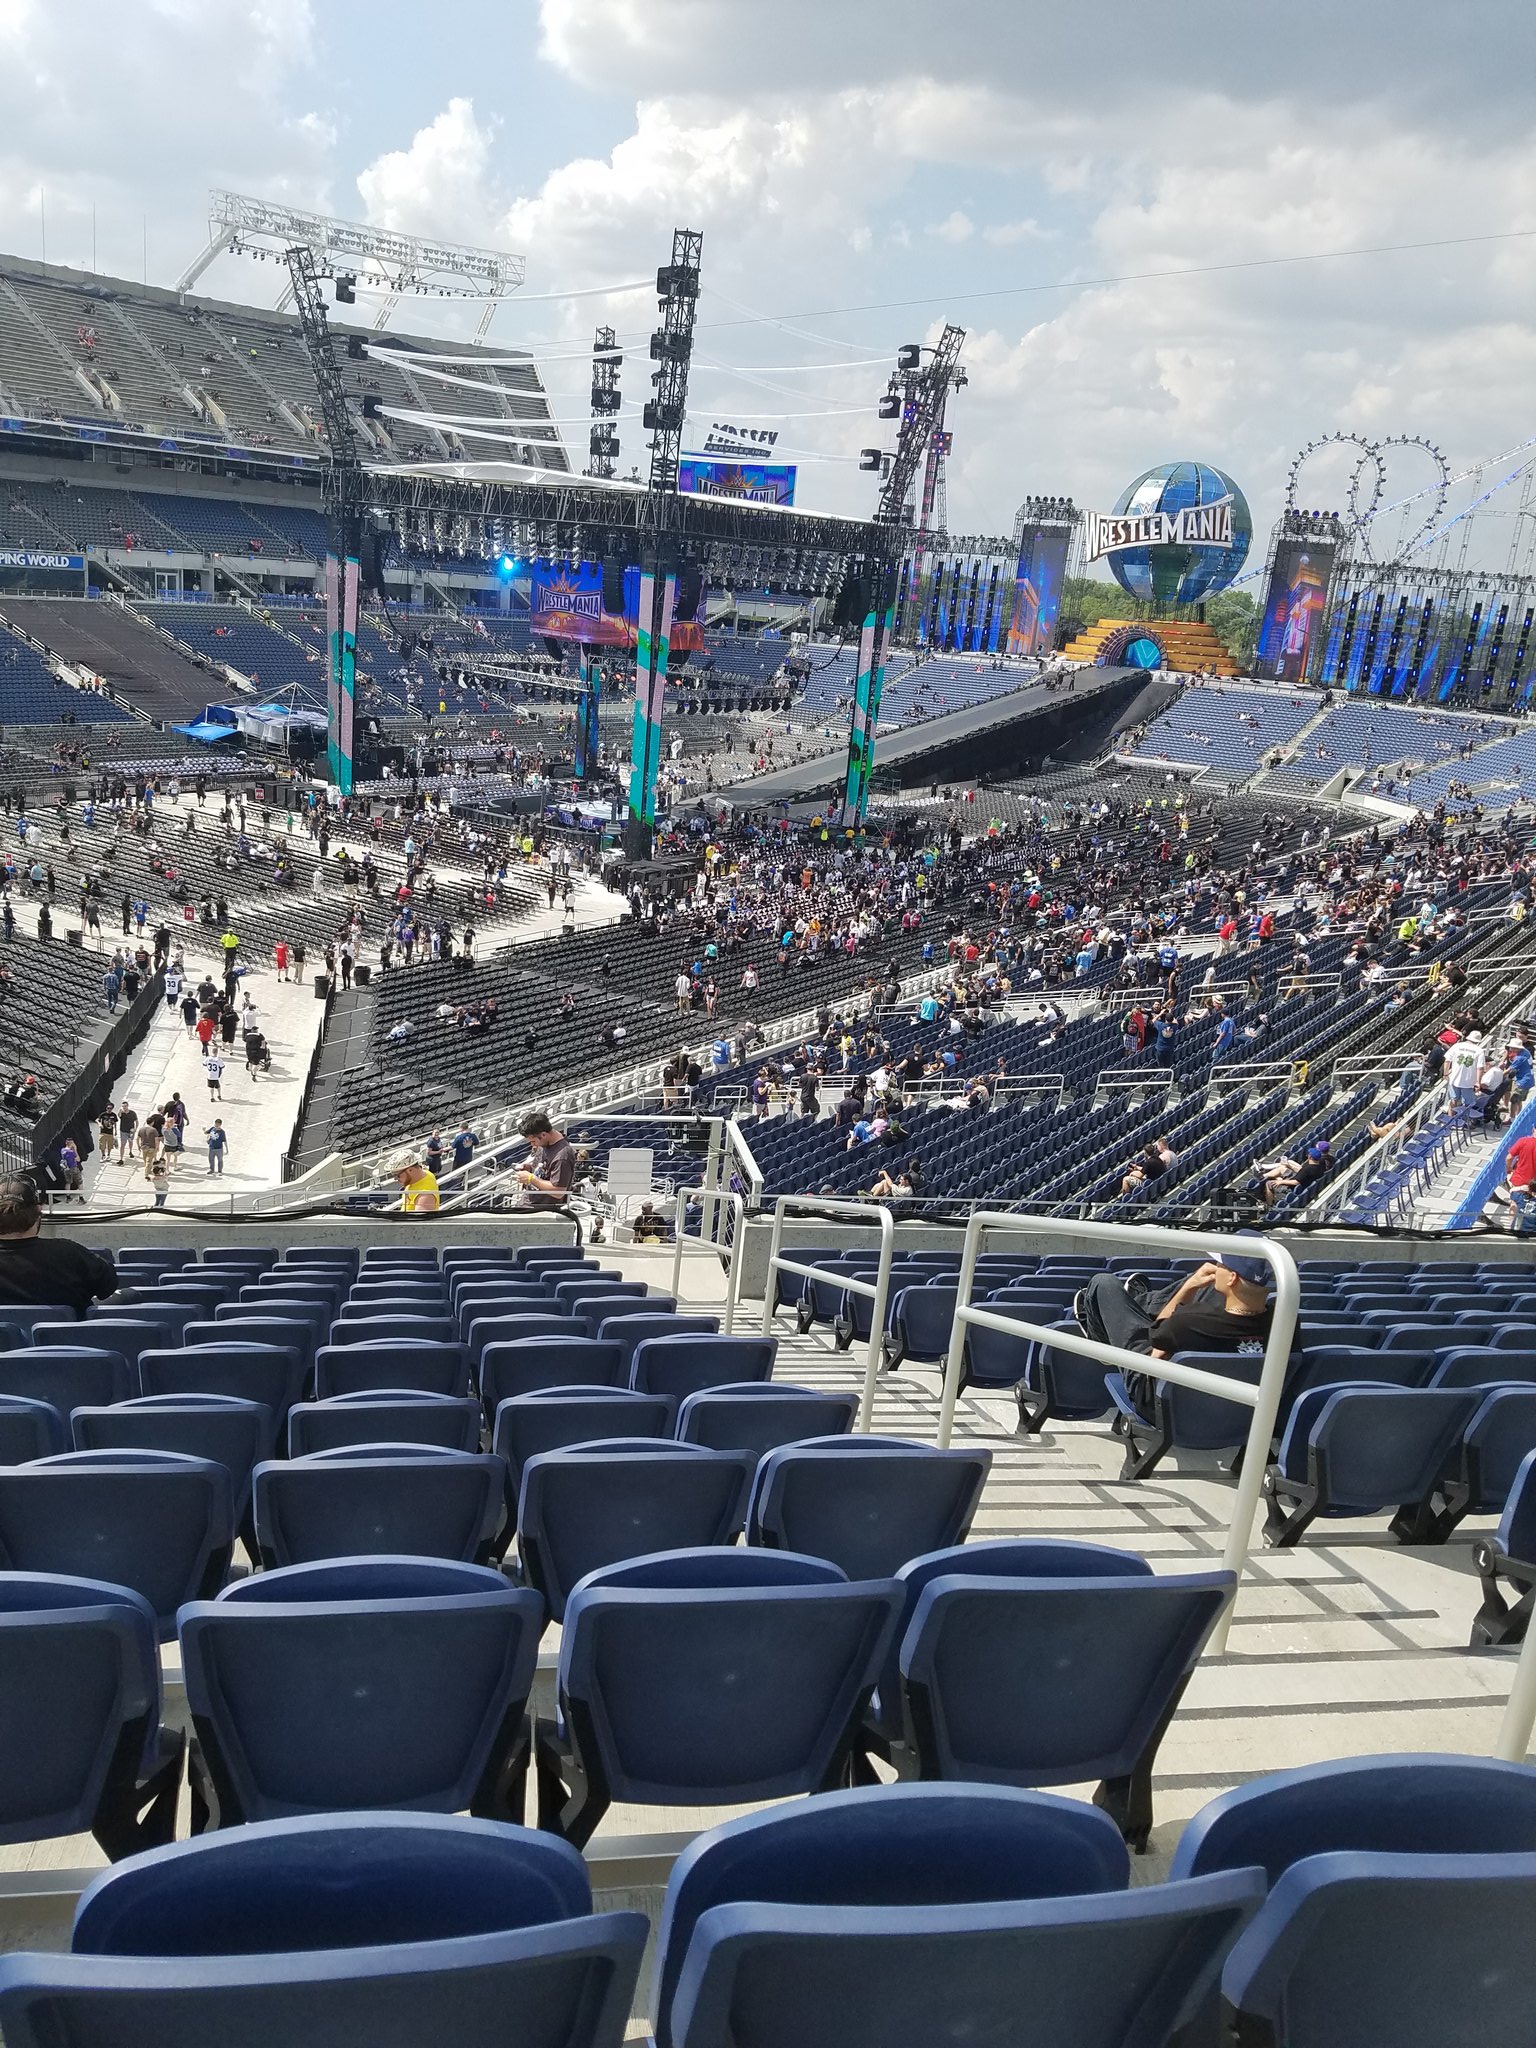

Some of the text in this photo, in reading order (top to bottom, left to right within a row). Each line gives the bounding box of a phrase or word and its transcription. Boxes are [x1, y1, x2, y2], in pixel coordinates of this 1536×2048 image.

[707, 445, 750, 455] SERVICES
[1085, 502, 1233, 563] WRESTLEMANIA
[27, 554, 70, 568] WORLD
[537, 585, 599, 620] WRESTLEMANIA
[167, 980, 176, 988] 33
[208, 1062, 218, 1072] 33
[1264, 1473, 1271, 1488] K
[1479, 1550, 1486, 1567] L
